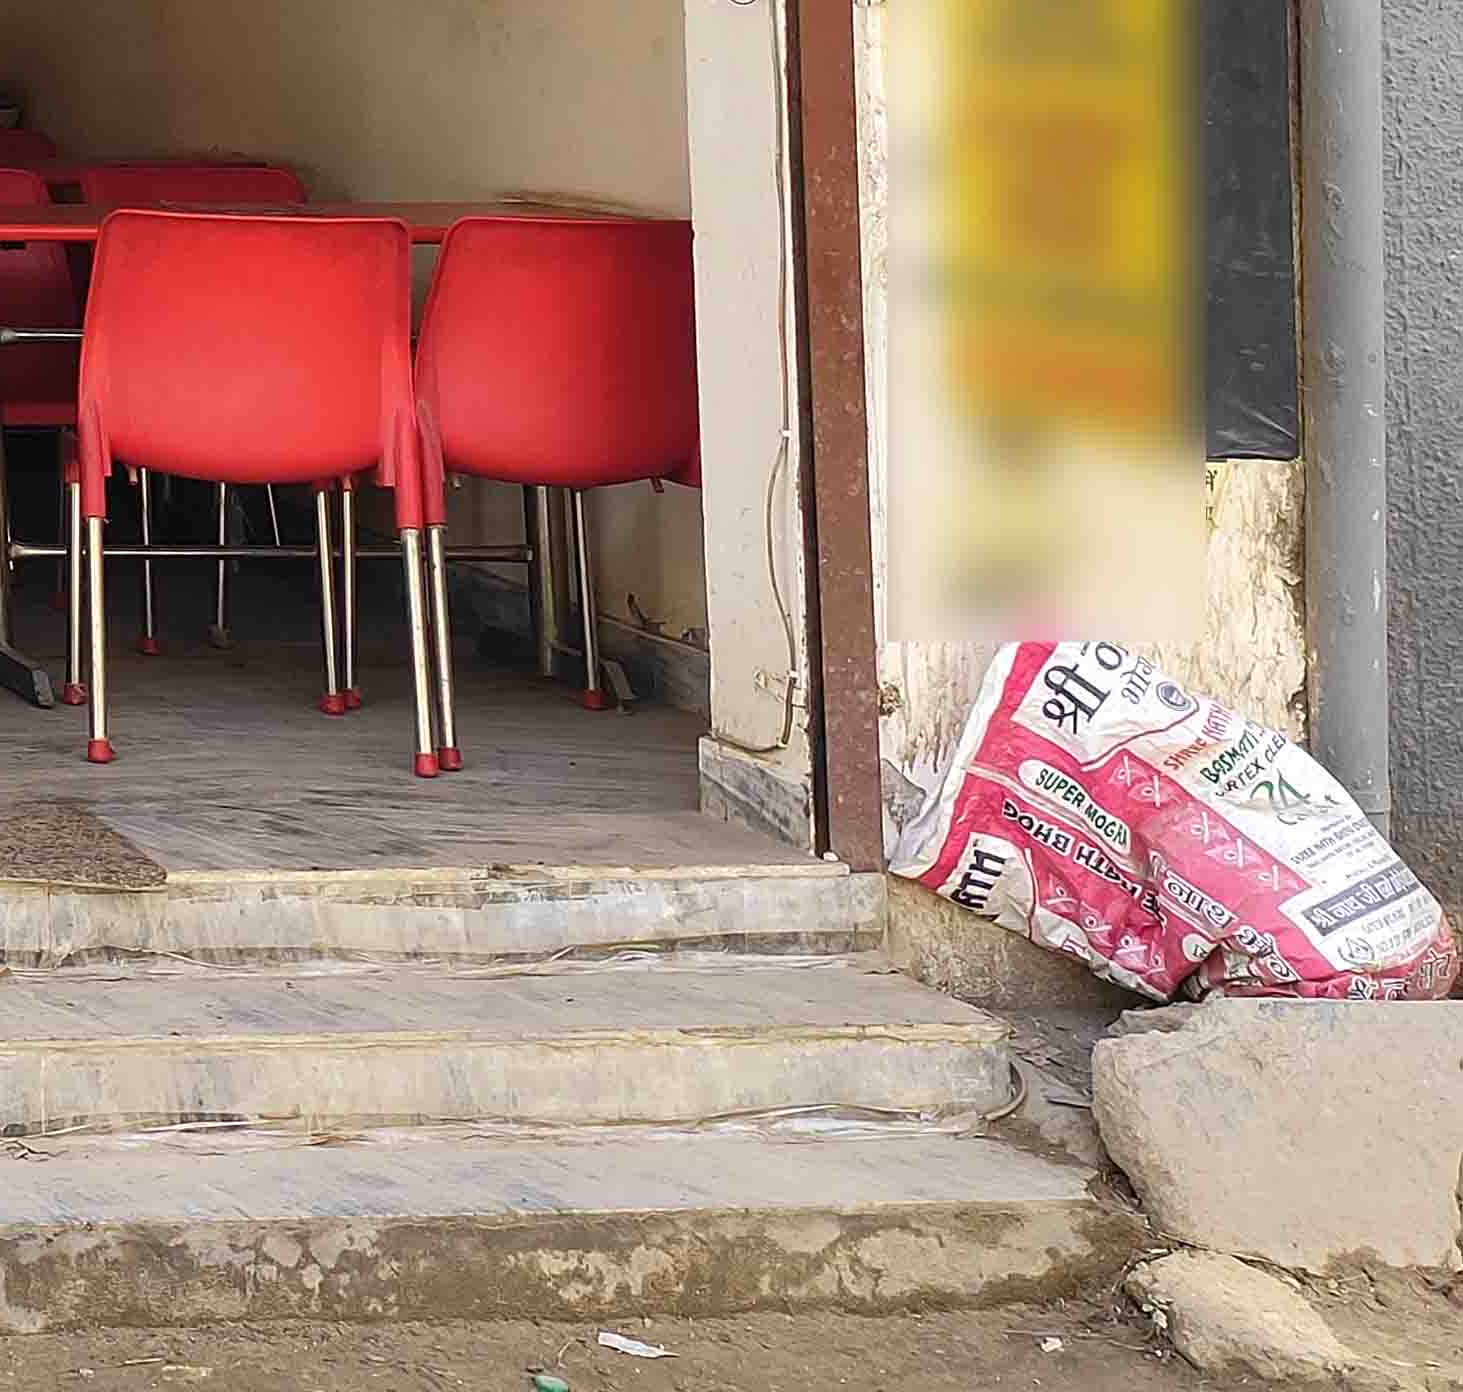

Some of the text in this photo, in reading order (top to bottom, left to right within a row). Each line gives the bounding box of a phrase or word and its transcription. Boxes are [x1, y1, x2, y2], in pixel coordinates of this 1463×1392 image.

[1042, 663, 1111, 735] श्री
[1035, 768, 1086, 808] SUPER
[1002, 799, 1073, 856] BHOG
[1165, 870, 1240, 929] नाथ
